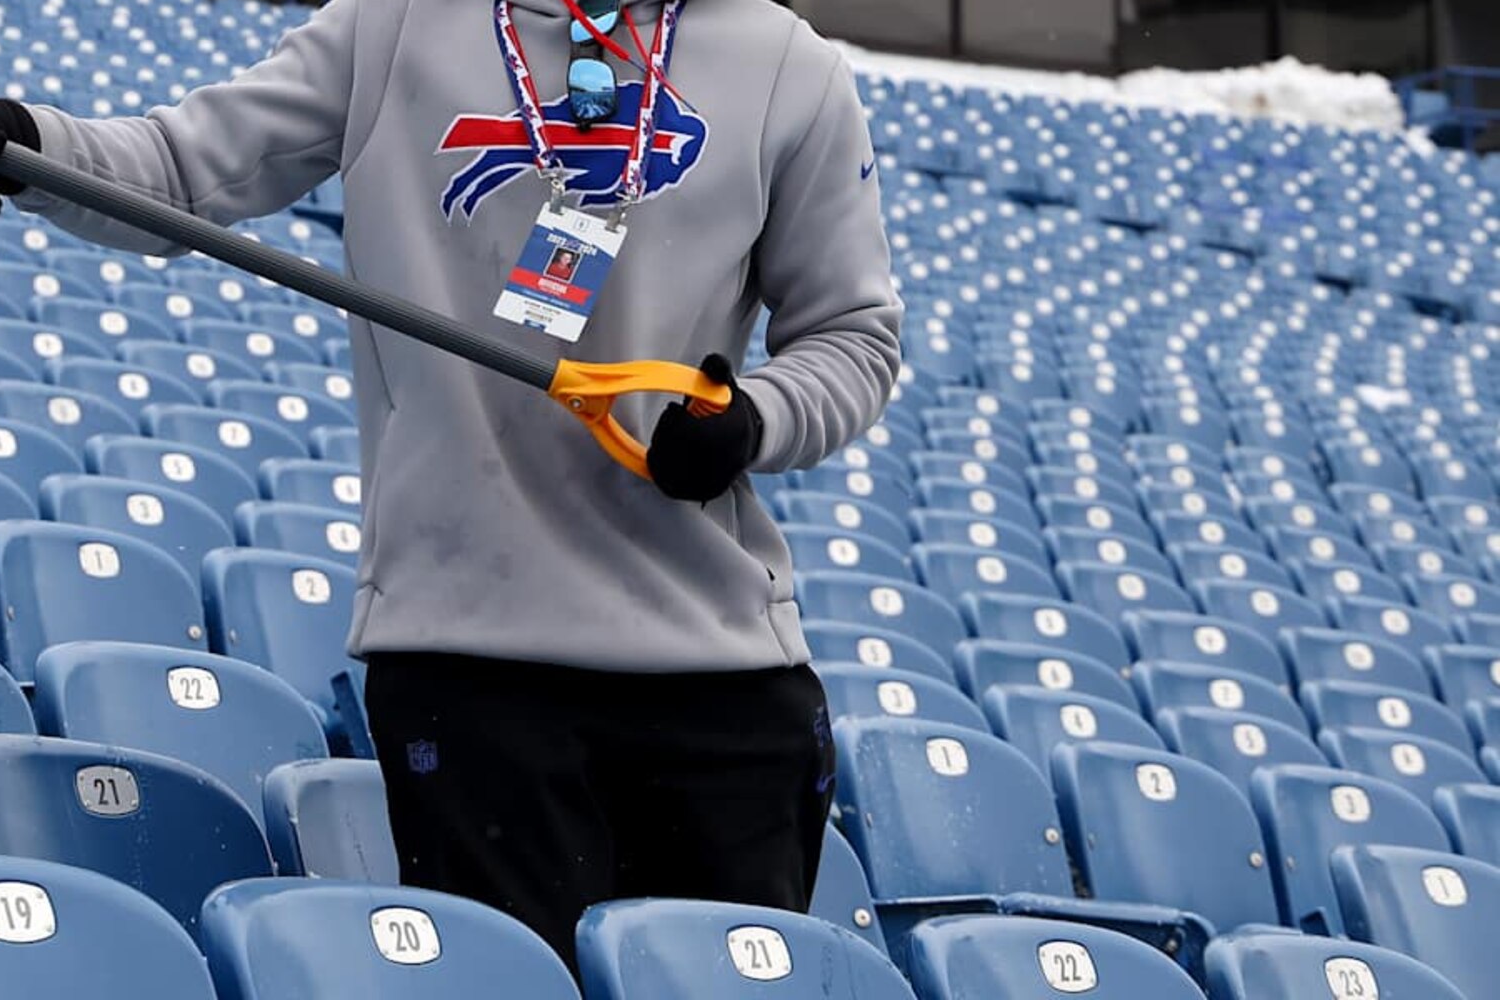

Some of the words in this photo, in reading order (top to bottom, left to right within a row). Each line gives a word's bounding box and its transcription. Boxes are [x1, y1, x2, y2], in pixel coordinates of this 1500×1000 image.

[179, 678, 204, 700] 22
[93, 778, 120, 806] 21
[0, 895, 32, 929] 19
[388, 922, 420, 952] 20
[744, 939, 773, 968] 21
[1053, 955, 1082, 982] 22
[1338, 970, 1364, 997] 23
